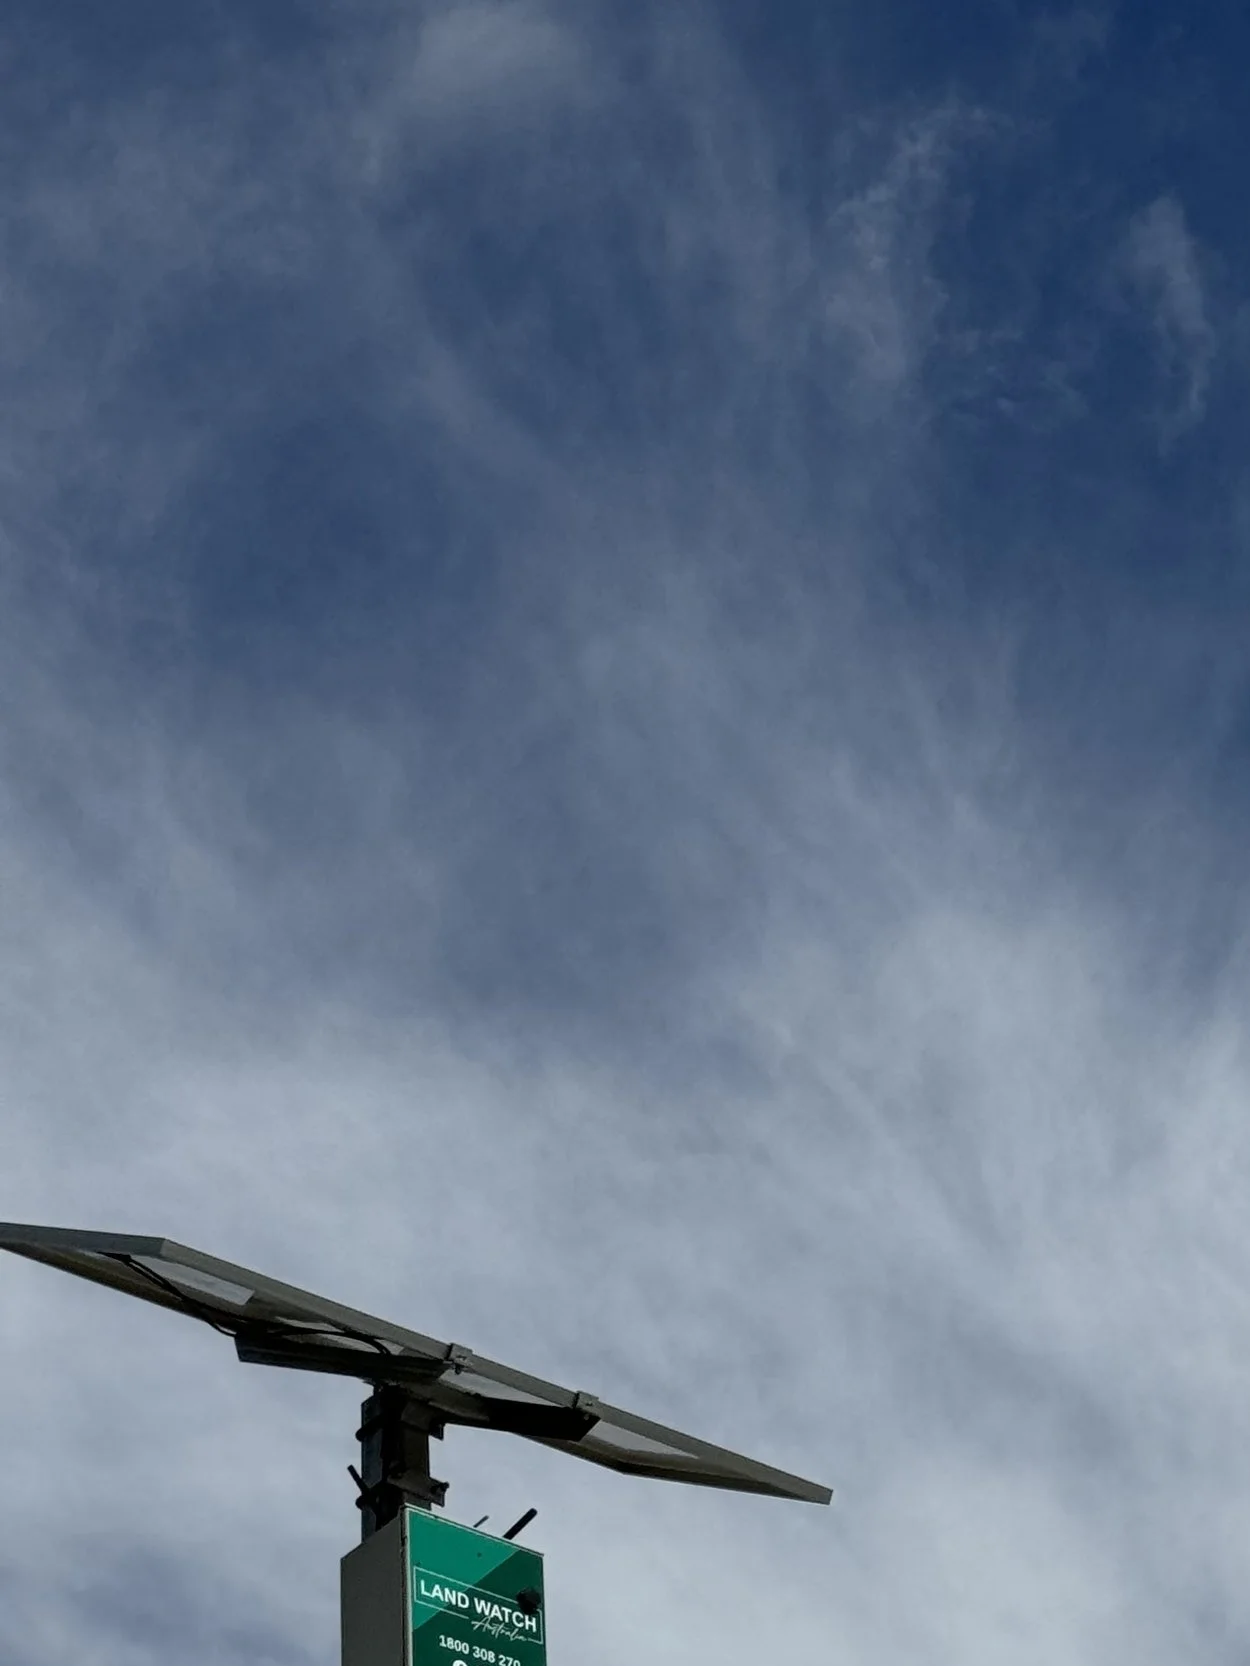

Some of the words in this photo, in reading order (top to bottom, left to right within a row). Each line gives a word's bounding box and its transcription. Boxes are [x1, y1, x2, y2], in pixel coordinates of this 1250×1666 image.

[420, 1579, 469, 1609] LAND
[474, 1597, 537, 1633] WATCH
[439, 1634, 469, 1655] 1800
[472, 1645, 495, 1663] 308
